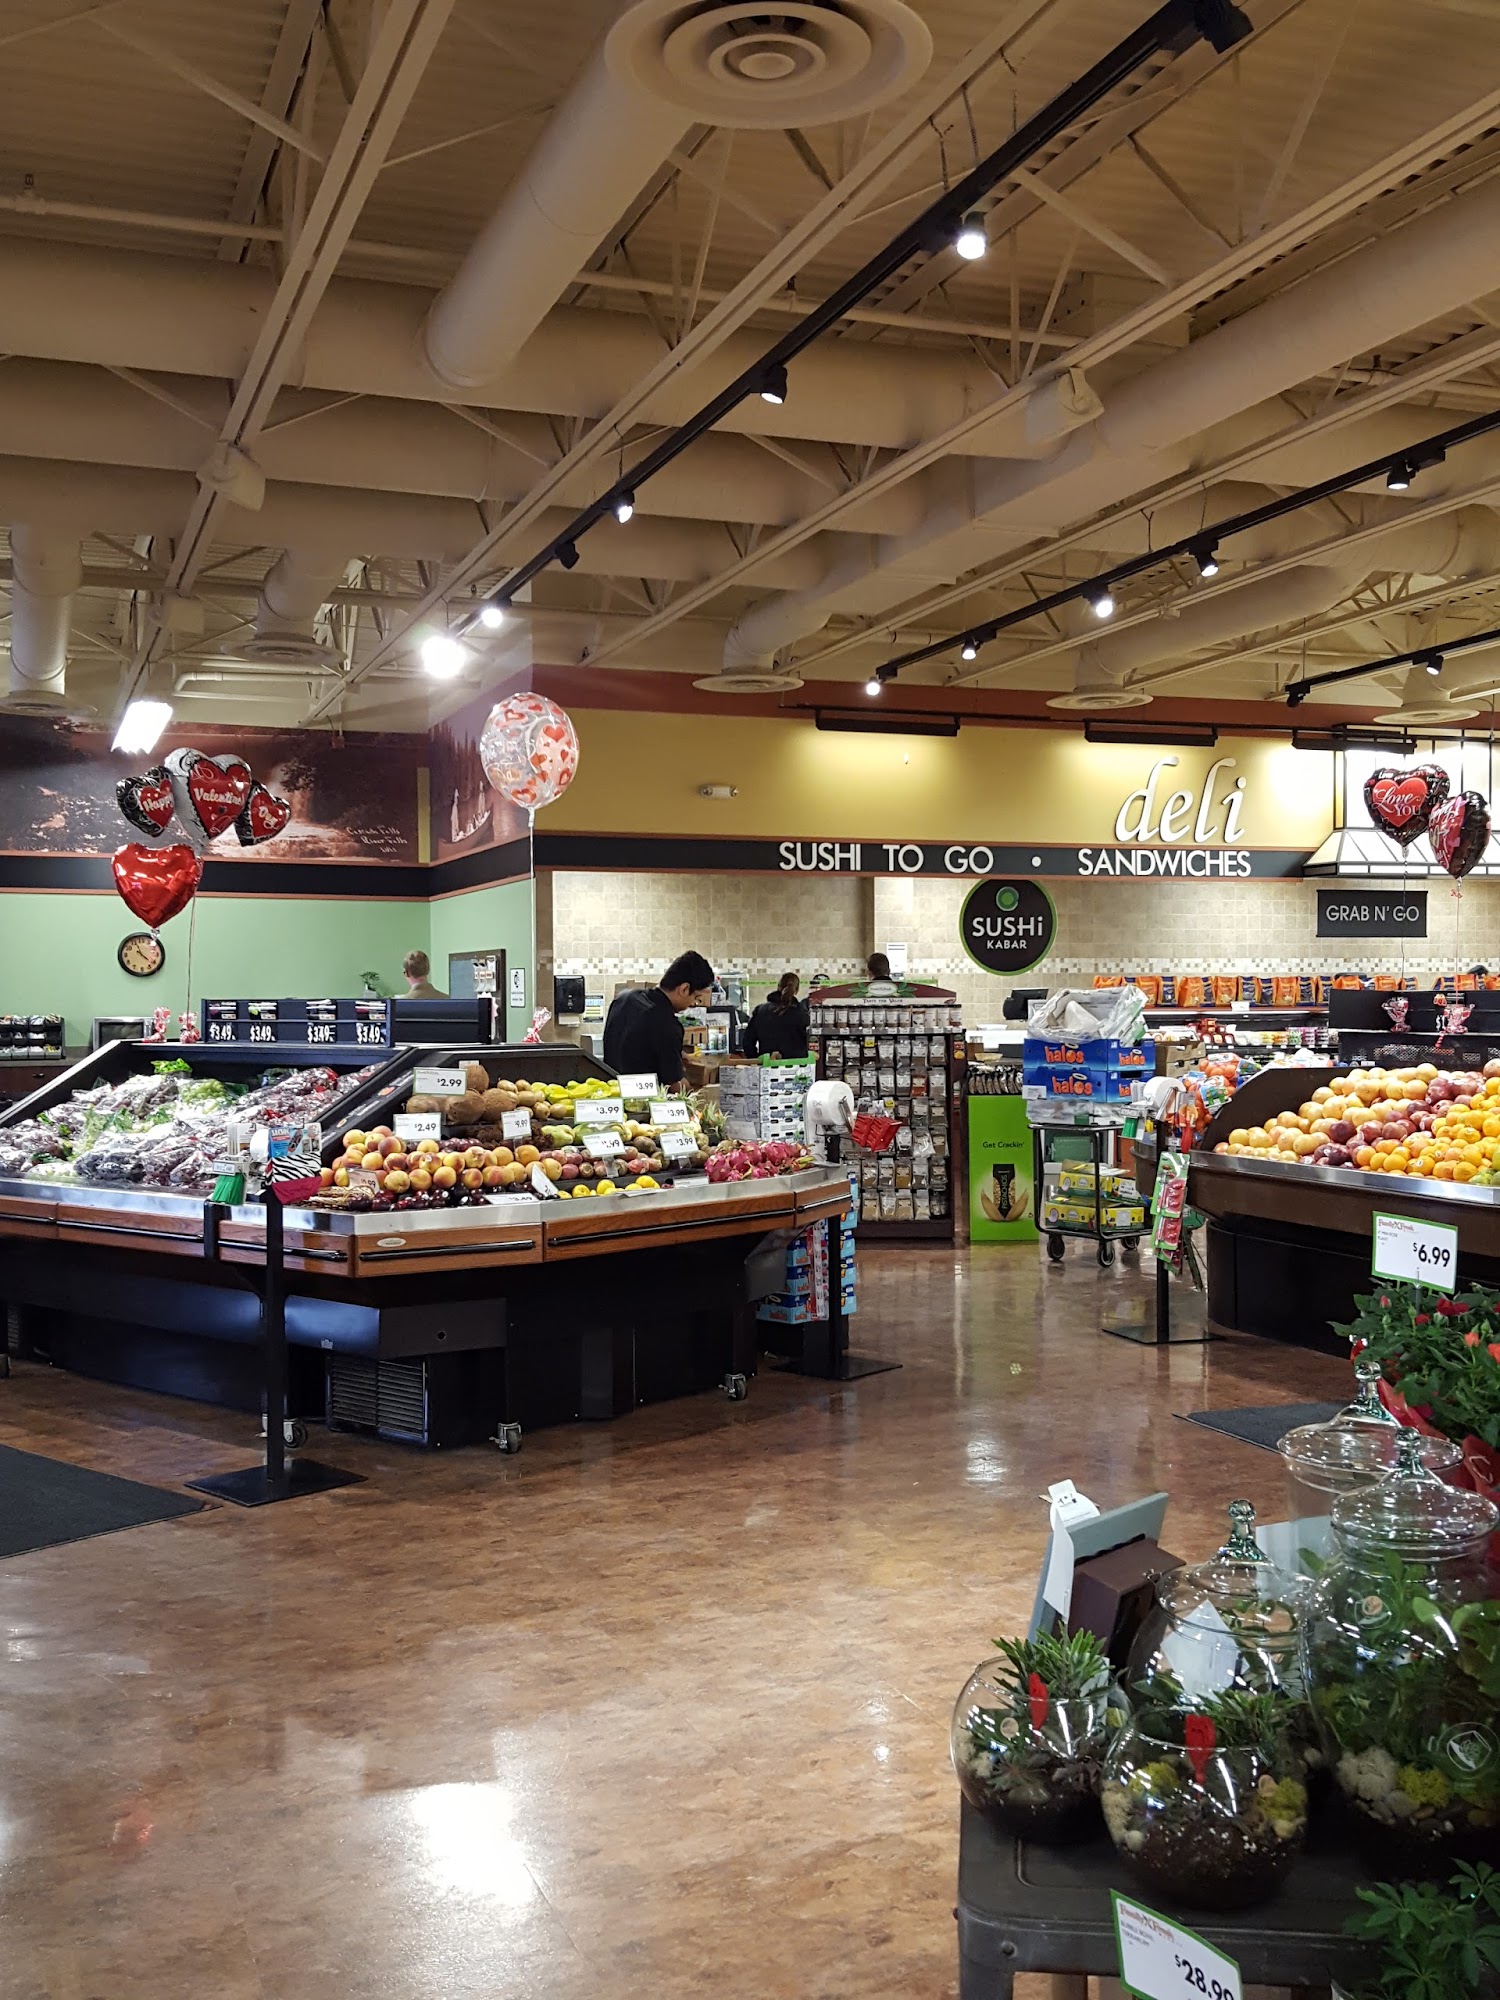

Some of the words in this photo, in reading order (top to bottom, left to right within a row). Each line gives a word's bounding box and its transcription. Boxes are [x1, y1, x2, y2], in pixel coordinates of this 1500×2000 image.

[142, 793, 174, 812] Happy
[1115, 756, 1247, 843] deli
[1372, 786, 1421, 813] Love
[1394, 803, 1422, 816] YOU
[360, 835, 385, 845] River
[779, 842, 862, 871] SUSHI
[882, 844, 924, 873] TO
[944, 846, 994, 874] GO
[1078, 849, 1252, 878] SANDWICHES
[1326, 905, 1370, 922] GRAB
[1374, 905, 1390, 922] N'
[1393, 906, 1420, 922] GO
[987, 940, 1028, 950] KABAR
[209, 1022, 231, 1041] $3.49
[250, 1025, 272, 1042] $3.49
[1044, 1045, 1085, 1064] halos
[1118, 1052, 1146, 1066] halos
[437, 1078, 462, 1087] $2.99
[635, 1082, 654, 1090] $3.99
[1051, 1075, 1094, 1096] halos
[596, 1106, 620, 1115] $3.99
[667, 1109, 685, 1117] $3.99
[414, 1123, 437, 1132] $2.49
[676, 1138, 694, 1146] $3.99
[982, 1141, 996, 1149] Get
[1412, 1242, 1451, 1268] $6.99
